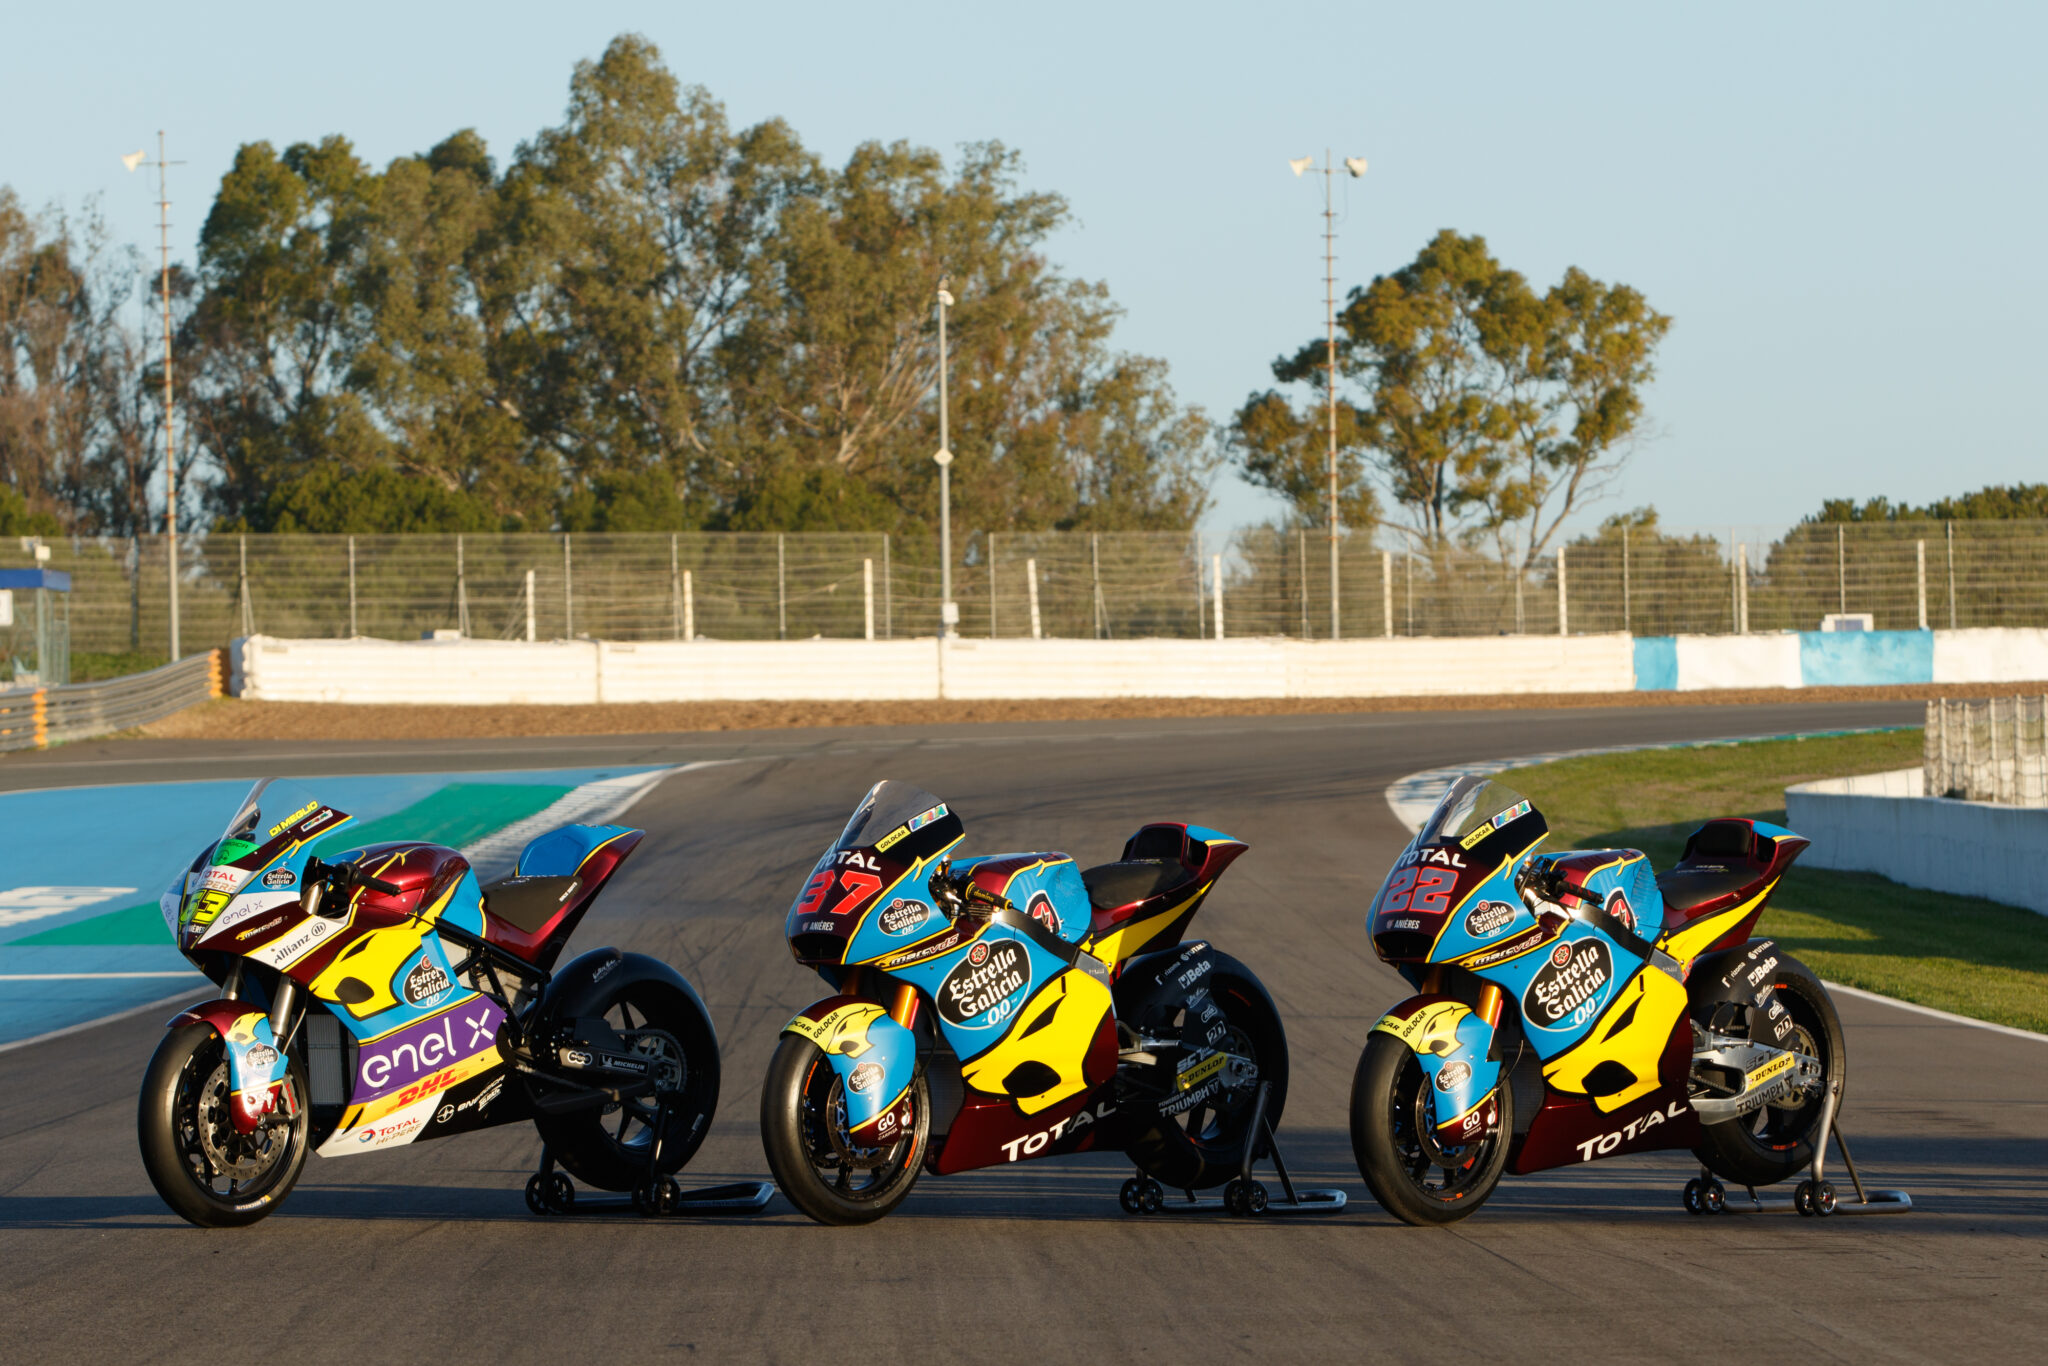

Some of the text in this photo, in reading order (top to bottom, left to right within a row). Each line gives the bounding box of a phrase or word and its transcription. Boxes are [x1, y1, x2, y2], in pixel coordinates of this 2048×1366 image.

[269, 800, 318, 837] DI MEGLIO
[880, 829, 906, 849] GOLDCAR
[1465, 827, 1490, 846] GOLDCAR
[819, 850, 881, 871] TOTAL
[1400, 848, 1467, 869] TOTAL
[204, 870, 237, 883] OTAL
[797, 870, 883, 915] 37
[974, 889, 994, 902] domino
[1380, 866, 1459, 915] 22
[222, 904, 250, 925] enel
[884, 903, 921, 923] Estrella
[888, 913, 923, 931] Galicia
[1470, 905, 1508, 926] Estrella
[1475, 915, 1510, 933] Galicia
[274, 933, 311, 964] Allianz
[890, 933, 959, 966] marcvds
[1475, 932, 1543, 966] marcvds
[410, 968, 441, 989] Estrel
[949, 949, 1018, 1002] Estrella
[1186, 960, 1211, 983] Beta
[1535, 946, 1599, 1005] Estrella
[1730, 961, 1746, 977] rizoma
[1754, 956, 1778, 980] Beta
[413, 977, 450, 1000] Galicia
[959, 970, 1023, 1017] Galicia
[1546, 967, 1606, 1019] Galicia
[813, 1012, 840, 1039] GOLDCAR
[1402, 1010, 1427, 1038] GOLDCAR
[362, 1017, 457, 1088] enel
[613, 1060, 645, 1071] MICHELIN
[1188, 1056, 1224, 1082] DUNLOP
[1755, 1057, 1791, 1081] DUNLOP
[397, 1068, 457, 1108] DHL
[1737, 1082, 1784, 1113] TRIUMPH
[1159, 1085, 1210, 1118] TRIUMPH
[379, 1117, 419, 1136] TOTAL
[877, 1112, 895, 1131] GO
[1001, 1102, 1116, 1162] TOTAL
[1463, 1111, 1480, 1130] GO
[1576, 1101, 1687, 1162] TOTAL
